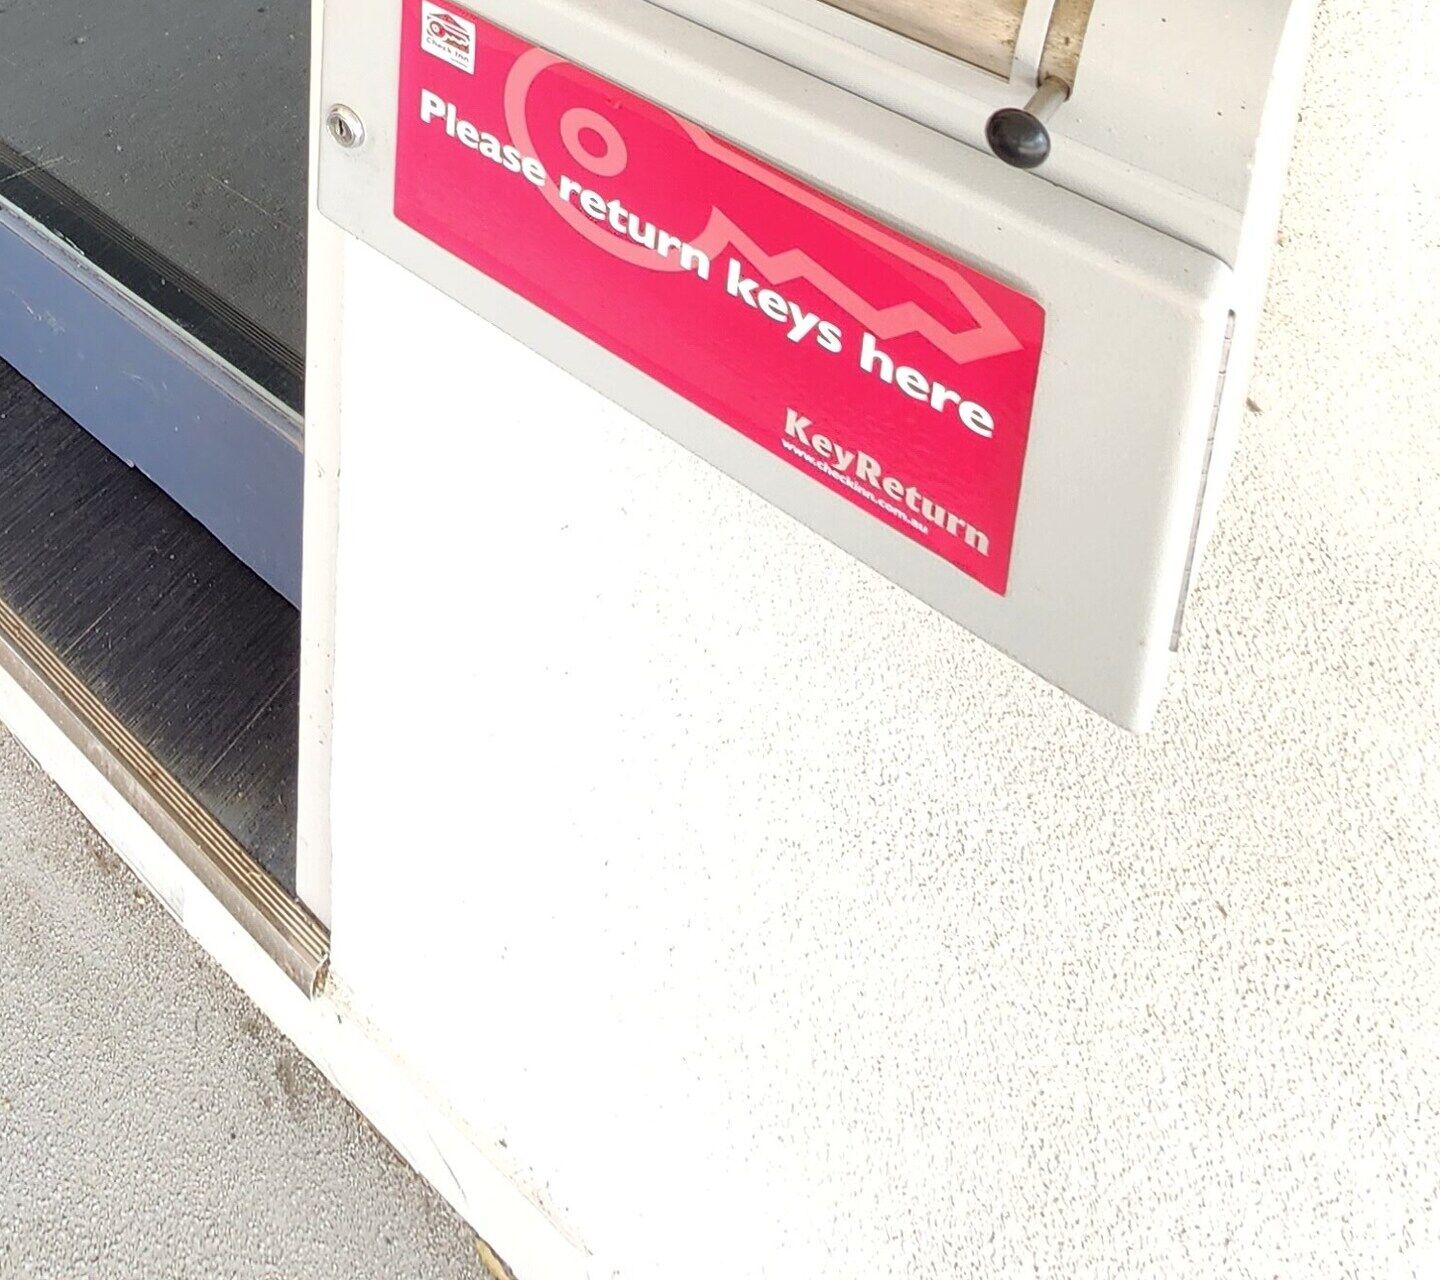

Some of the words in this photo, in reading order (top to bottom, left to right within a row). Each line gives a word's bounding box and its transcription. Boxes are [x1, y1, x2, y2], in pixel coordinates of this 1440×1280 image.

[426, 36, 452, 54] Check
[420, 88, 546, 186] Please
[559, 174, 710, 281] return
[726, 257, 843, 353] keys
[859, 331, 995, 439] here
[781, 438, 929, 535] www.checkinn.com.au
[784, 407, 990, 557] KeyReturn
